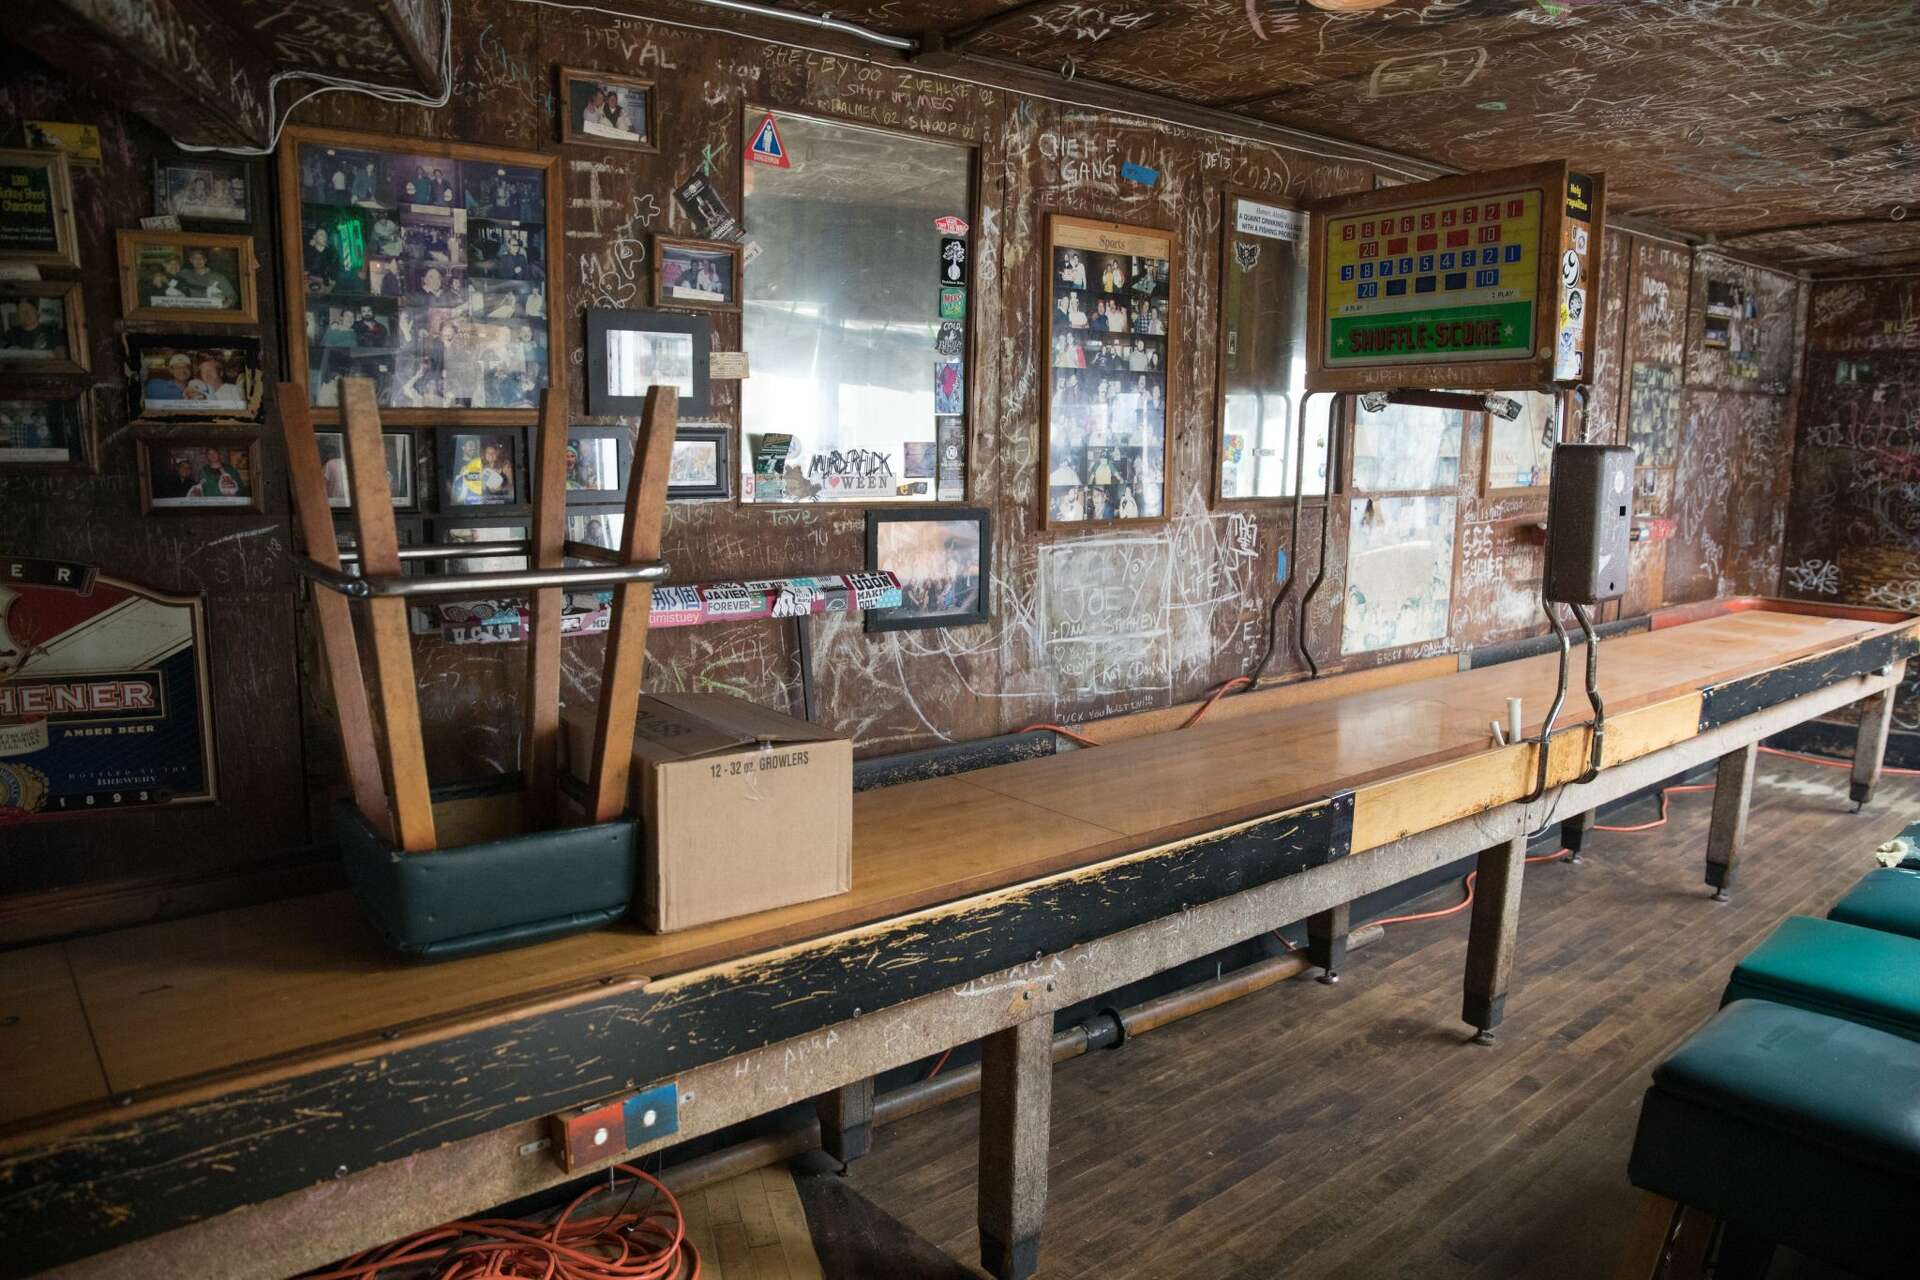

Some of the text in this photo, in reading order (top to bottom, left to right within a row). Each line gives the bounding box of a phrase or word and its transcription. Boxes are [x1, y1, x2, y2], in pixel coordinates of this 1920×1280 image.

[620, 42, 677, 70] VAL
[763, 44, 849, 82] SHELBY
[1063, 154, 1117, 183] GANG
[1344, 226, 1353, 239] 9
[1363, 223, 1372, 237] 8
[1384, 221, 1391, 233] 7
[1403, 217, 1411, 231] 6
[1423, 214, 1431, 228] 5
[1442, 212, 1451, 225] 4
[1465, 209, 1473, 223] 3
[1487, 206, 1496, 220] 2
[1099, 235, 1126, 249] Sports
[1362, 227, 1496, 257] 20 10
[1345, 267, 1352, 280] 9
[1363, 264, 1371, 277] 8
[1382, 261, 1390, 275] 7
[1402, 259, 1409, 272] 6
[1423, 256, 1431, 270] 5
[1442, 254, 1451, 268] 4
[1465, 251, 1472, 265] 3
[1486, 249, 1495, 263] 2
[1361, 271, 1494, 297] 20 10
[1497, 290, 1514, 298] PLAY
[1349, 319, 1503, 353] SHUFFLE-SCORE
[843, 476, 888, 489] WEEN
[705, 588, 749, 601] JAVIER
[751, 581, 768, 590] THE
[853, 576, 891, 591] UDON
[707, 600, 750, 612] FOREVER
[1062, 582, 1145, 623] JOEY
[64, 725, 156, 737] AMBER BEER
[711, 763, 721, 778] 12
[730, 762, 741, 776] 32
[759, 751, 809, 771] GROWLERS
